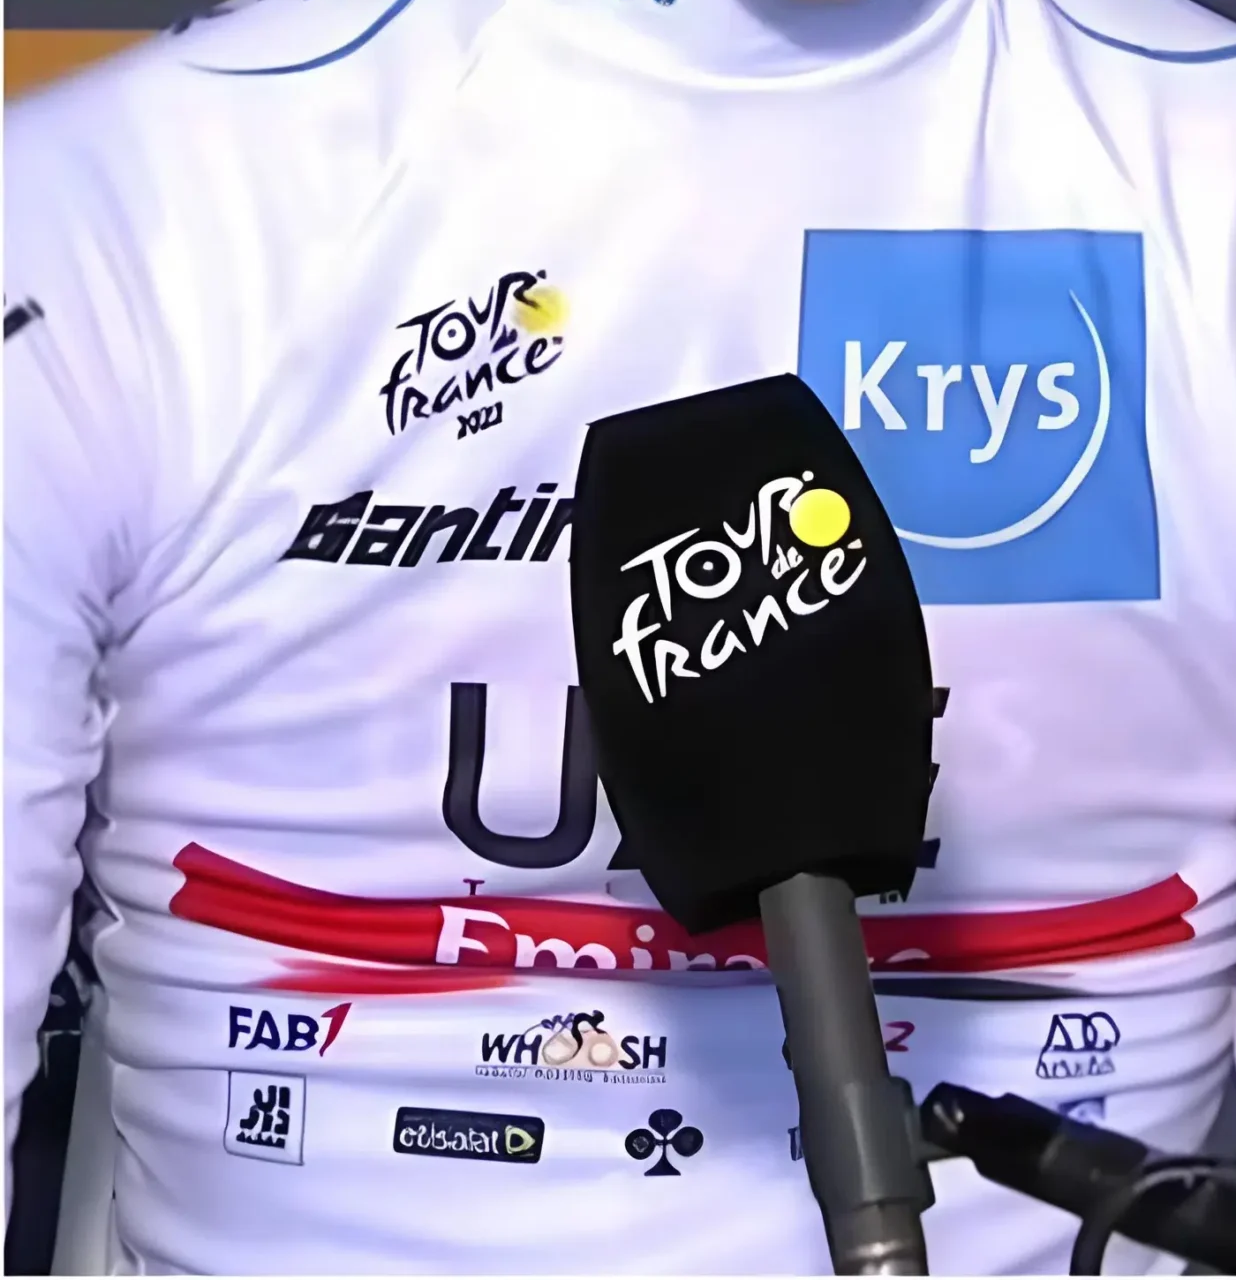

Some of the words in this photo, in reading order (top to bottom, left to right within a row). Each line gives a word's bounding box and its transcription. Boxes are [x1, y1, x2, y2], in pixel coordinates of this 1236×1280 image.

[843, 340, 1081, 464] Krys
[620, 470, 815, 621] TOUR
[612, 540, 867, 704] france
